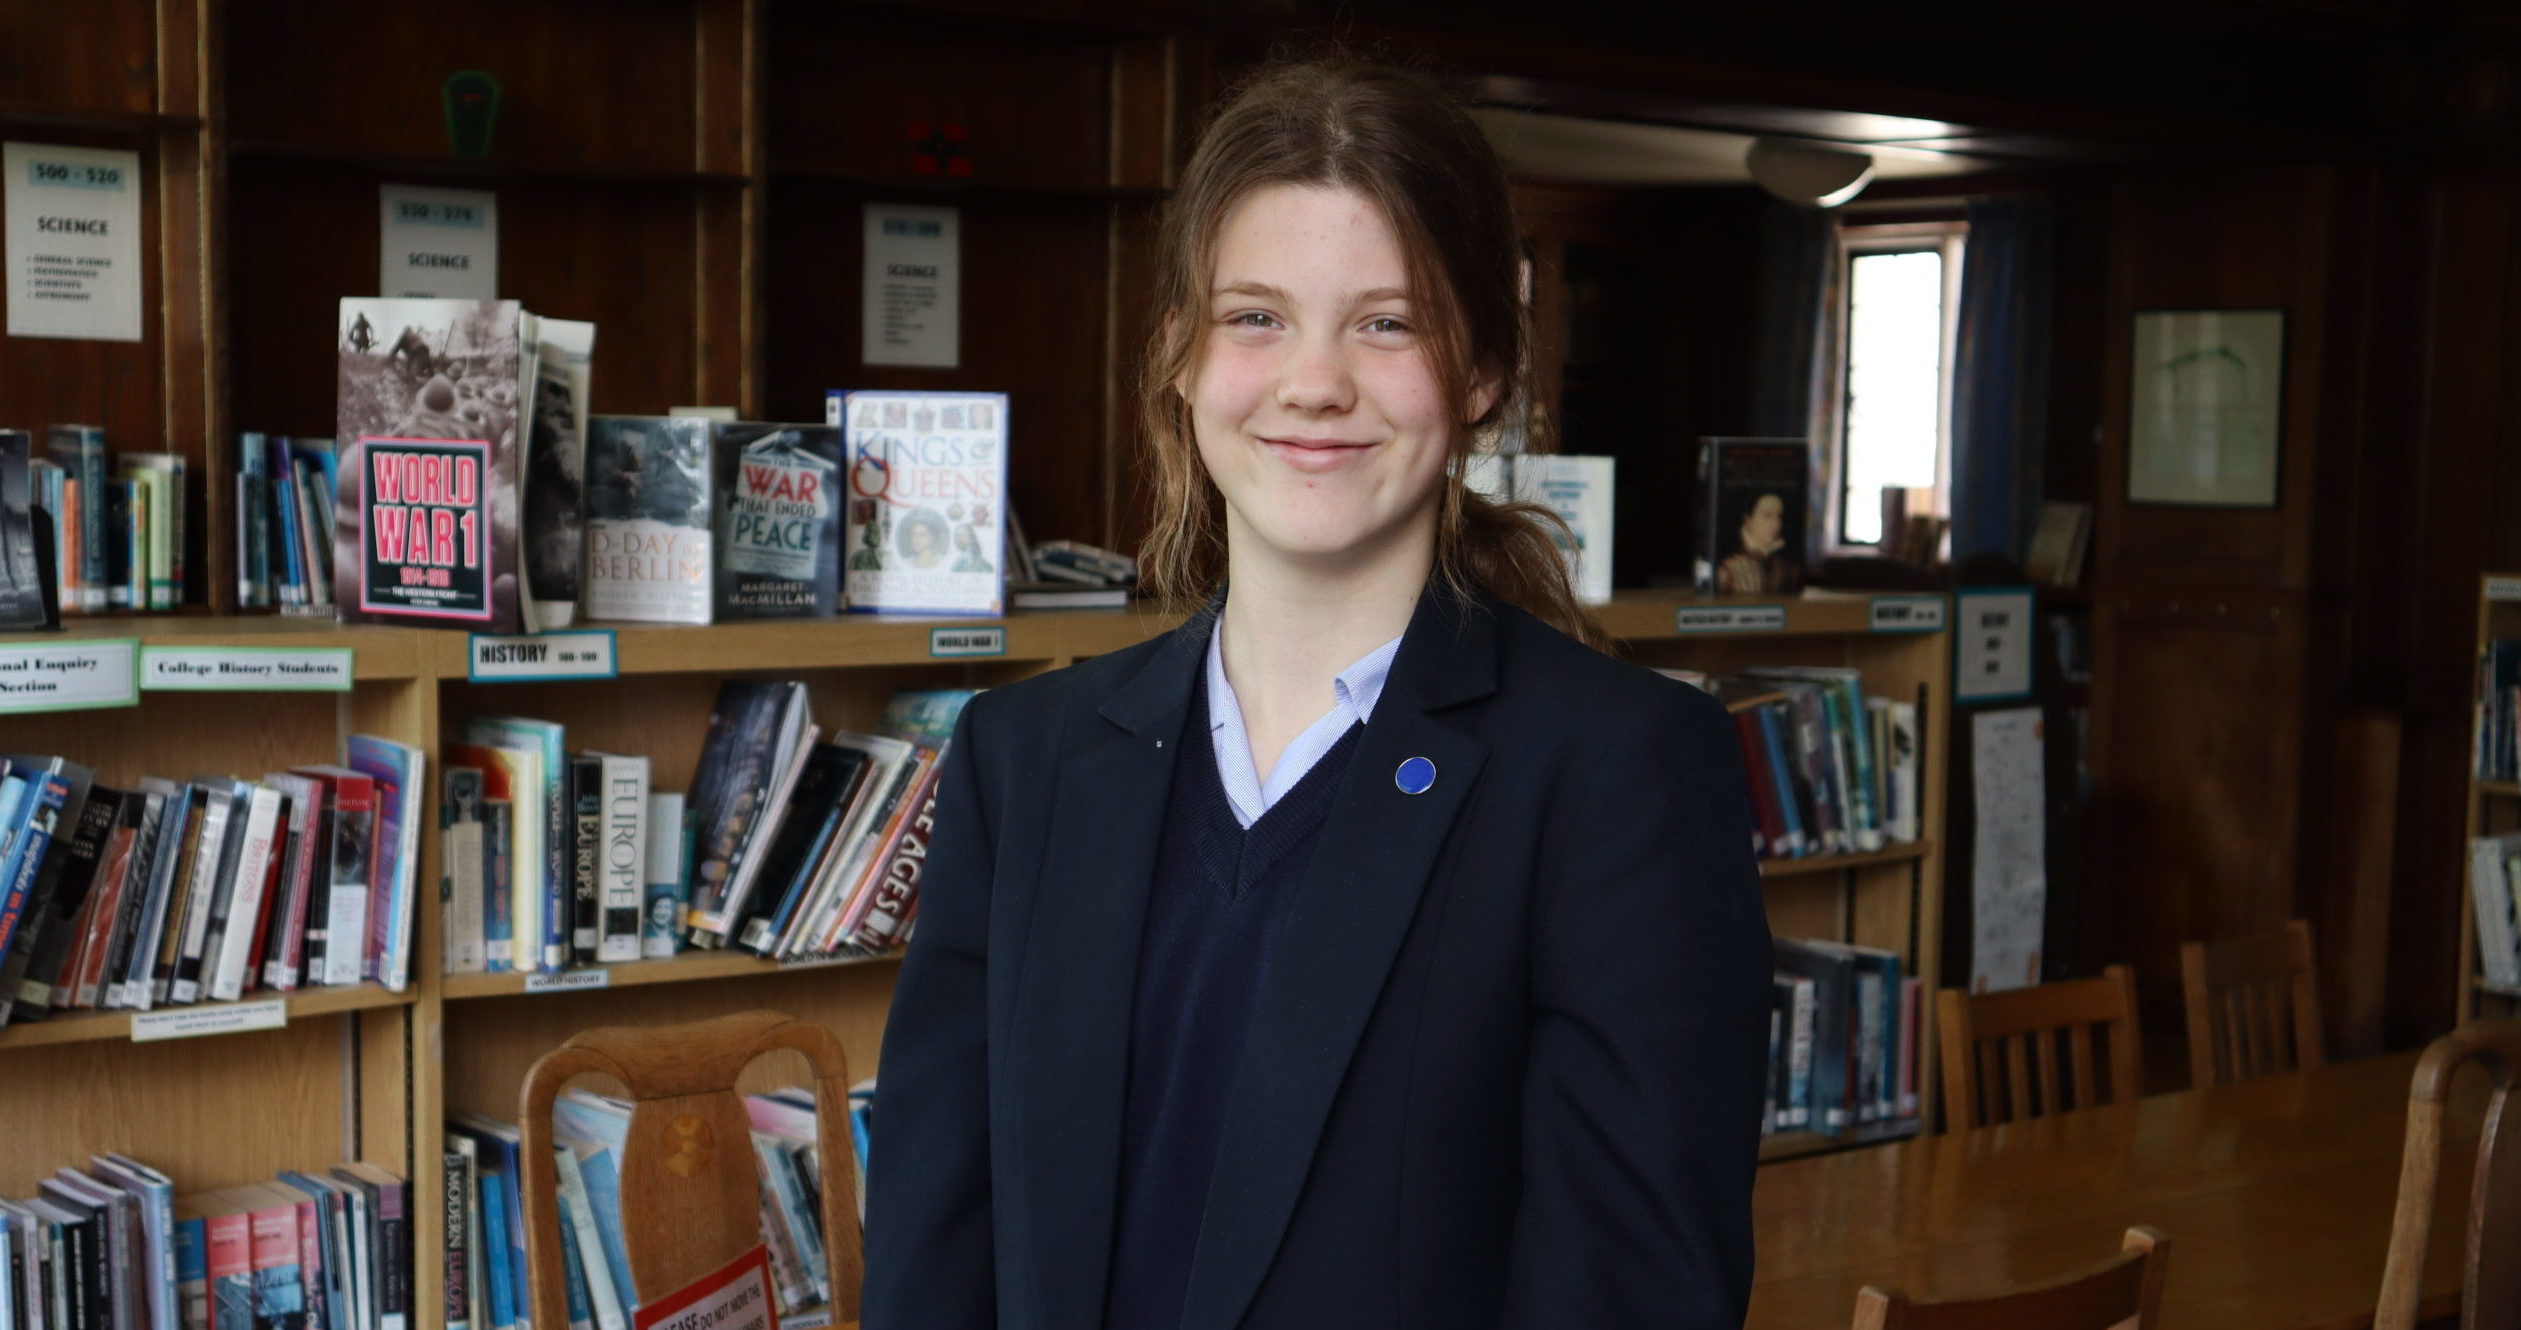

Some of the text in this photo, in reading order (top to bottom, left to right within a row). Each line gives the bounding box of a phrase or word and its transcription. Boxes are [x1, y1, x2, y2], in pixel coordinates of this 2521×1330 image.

[36, 163, 69, 180] 500
[37, 216, 109, 236] SCIENCE
[408, 252, 471, 270] SCIENCE
[887, 264, 938, 279] SCIENCE
[854, 431, 963, 471] KINGS
[373, 452, 478, 507] WORLD
[743, 465, 819, 503] WAR
[852, 456, 996, 508] QUEENS
[740, 498, 817, 518] THAT ENDED
[373, 506, 478, 567] WAR 1
[591, 531, 677, 555] D-DAY
[734, 516, 811, 551] PEACE
[591, 556, 703, 581] BERLIN
[392, 586, 403, 596] THE
[435, 590, 457, 600] FRONT
[741, 581, 804, 594] MARGARET
[35, 656, 97, 672] Enquiry
[480, 643, 547, 664] HISTORY
[158, 661, 339, 677] College History Students
[0, 680, 57, 692] Section
[608, 777, 639, 904] EUROPE
[576, 814, 600, 901] EUROPE
[876, 833, 928, 915] AGES
[531, 975, 600, 986] WORLD HISTORY
[446, 1170, 466, 1320] MODERN EUROPE
[699, 1313, 713, 1329] DO
[714, 1303, 729, 1322] NOT
[730, 1290, 750, 1313] MOVE
[748, 1284, 761, 1299] THE
